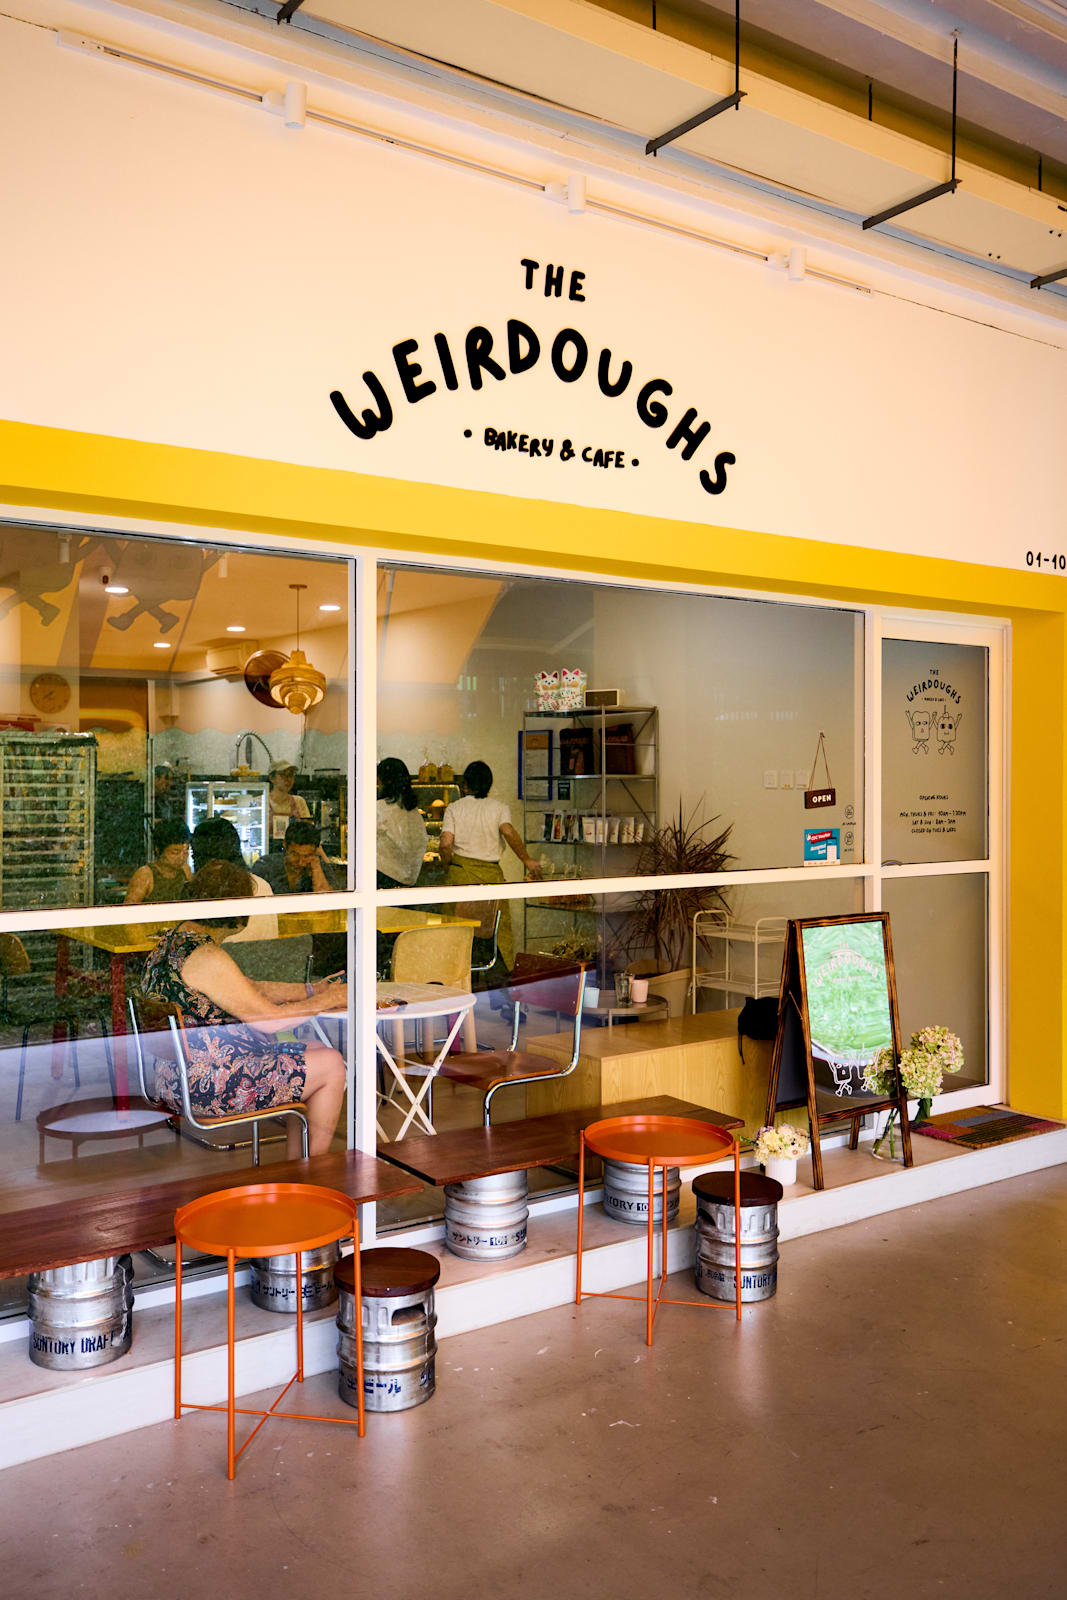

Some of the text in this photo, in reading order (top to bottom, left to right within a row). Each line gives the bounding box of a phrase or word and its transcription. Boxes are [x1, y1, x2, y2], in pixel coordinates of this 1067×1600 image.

[521, 259, 585, 302] THE
[330, 319, 735, 494] WEIRDOUGHS
[484, 428, 624, 468] BAKERY & CAFE
[1027, 551, 1066, 569] 01-10
[906, 679, 961, 704] WEIRDOUGHS
[812, 794, 832, 803] OPEN
